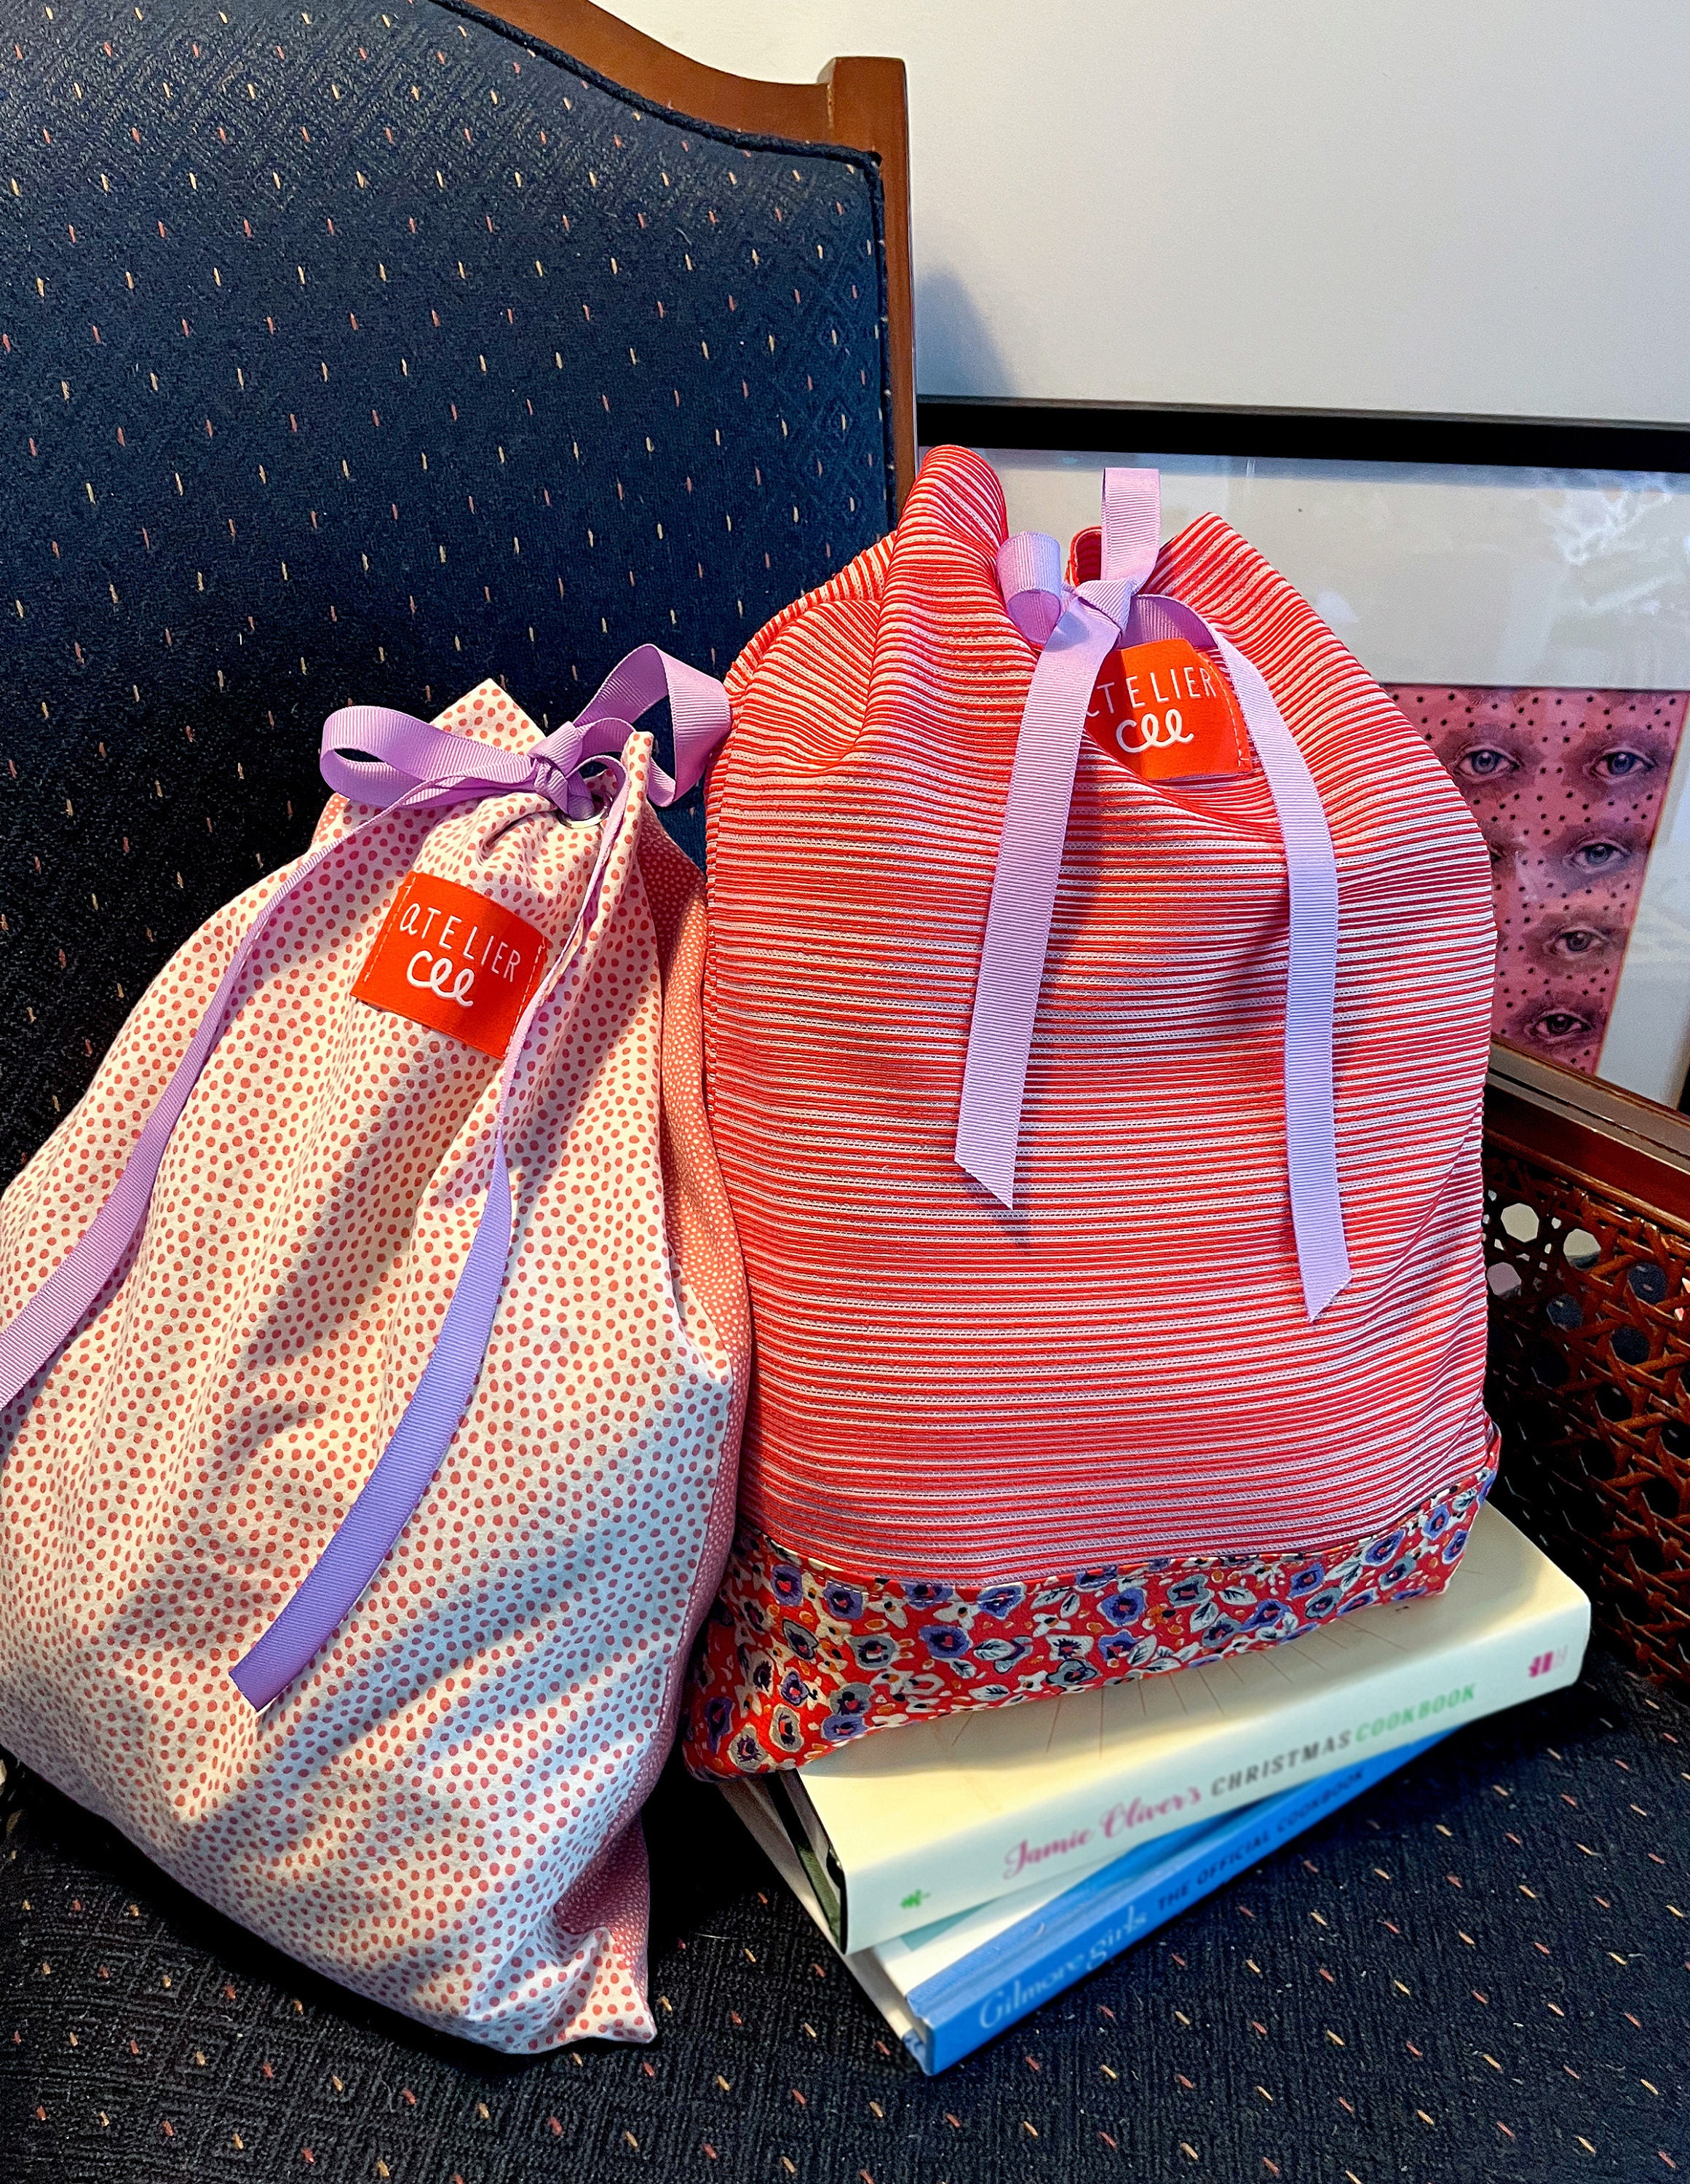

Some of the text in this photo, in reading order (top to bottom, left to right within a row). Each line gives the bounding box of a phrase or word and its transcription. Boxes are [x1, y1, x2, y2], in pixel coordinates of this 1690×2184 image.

[1086, 667, 1216, 717] TELIER
[1003, 1828, 1093, 1880] Jamie
[1211, 1730, 1352, 1797] CHRISTMAS
[1355, 1682, 1477, 1743] COOKBOOK
[980, 1765, 1364, 2028] Gilmore girls THE OFFICIAL COOKBOOK
